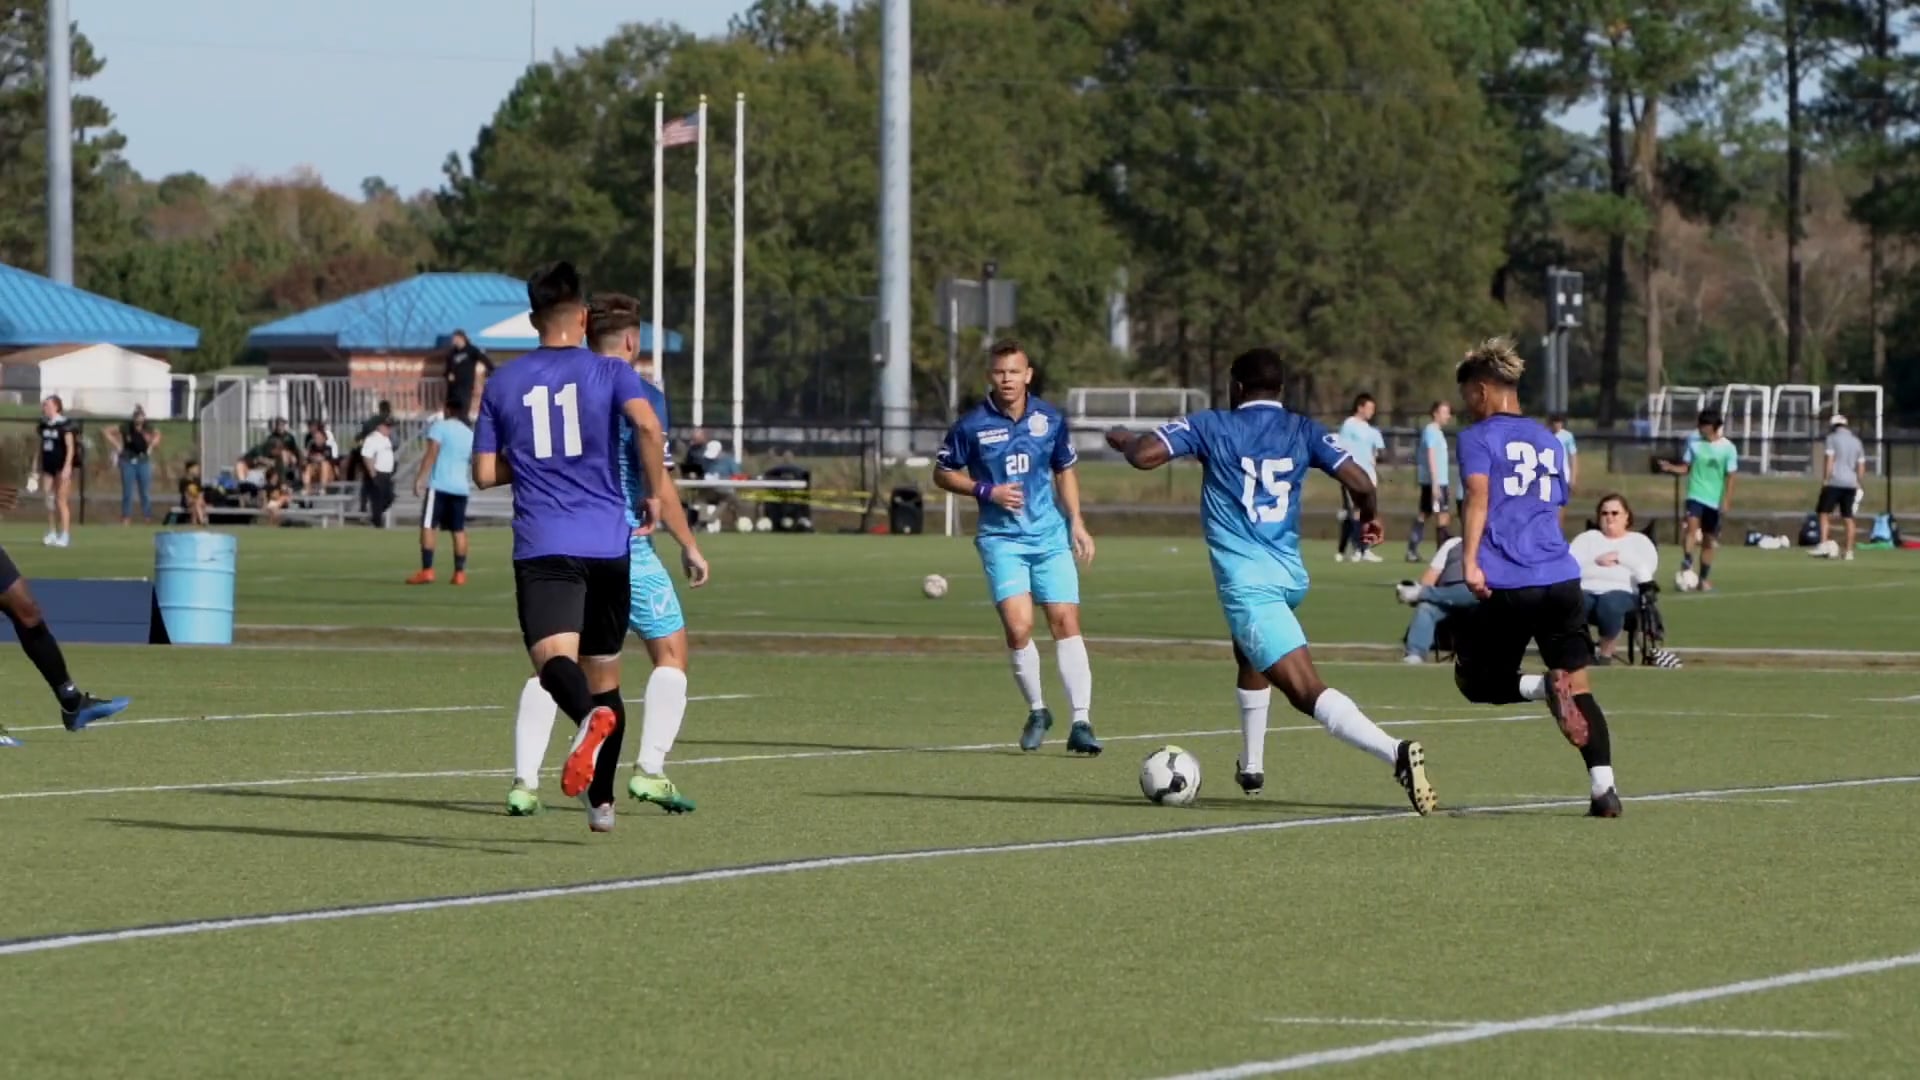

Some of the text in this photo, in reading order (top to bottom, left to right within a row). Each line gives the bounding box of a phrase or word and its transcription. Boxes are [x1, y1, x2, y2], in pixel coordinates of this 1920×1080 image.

[523, 383, 582, 458] 11
[1006, 453, 1029, 476] 20
[1241, 457, 1293, 523] 15
[1504, 442, 1558, 502] 31
